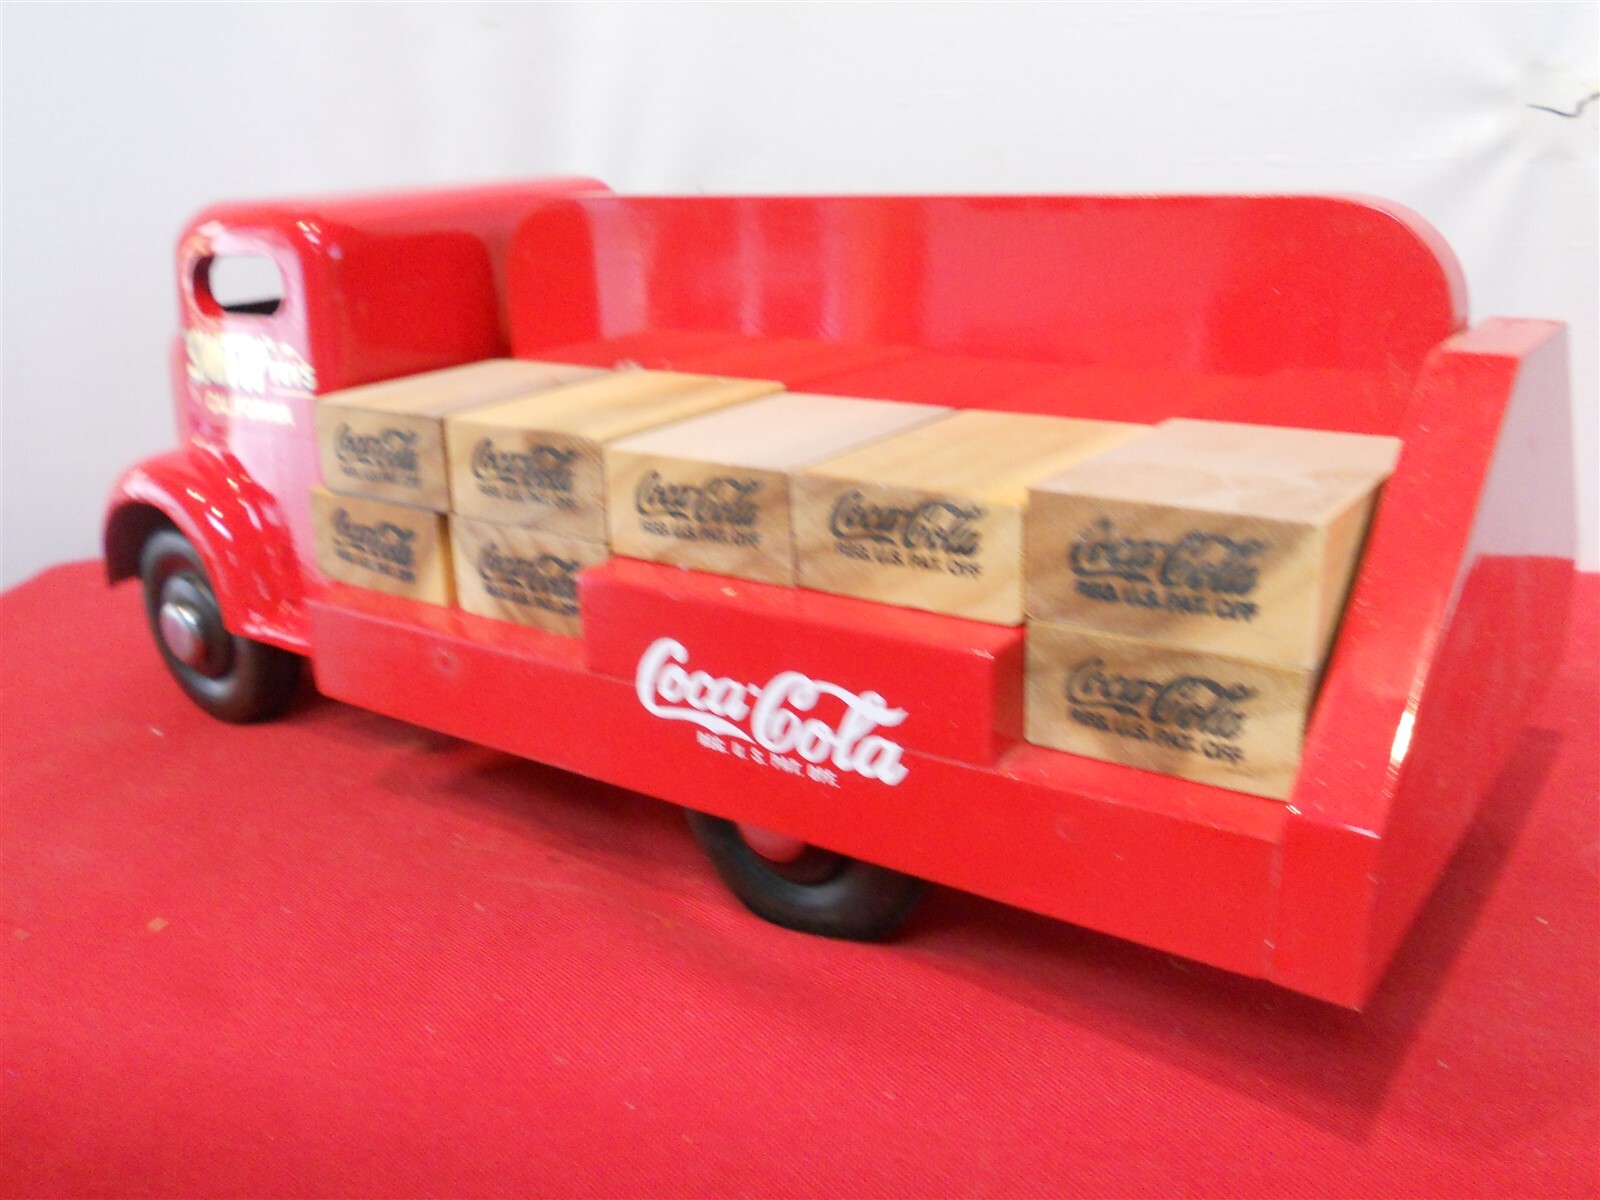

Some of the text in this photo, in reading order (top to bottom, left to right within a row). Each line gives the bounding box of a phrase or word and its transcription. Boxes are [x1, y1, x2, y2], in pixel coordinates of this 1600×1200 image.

[471, 438, 576, 492] Coca-Cola
[633, 469, 761, 527] Coca-Cola
[829, 489, 988, 555] Coca-Cola
[1068, 519, 1268, 595] Coca-Cola
[636, 637, 909, 786] Coca-Cola
[1065, 657, 1259, 740] Coca-Cola
